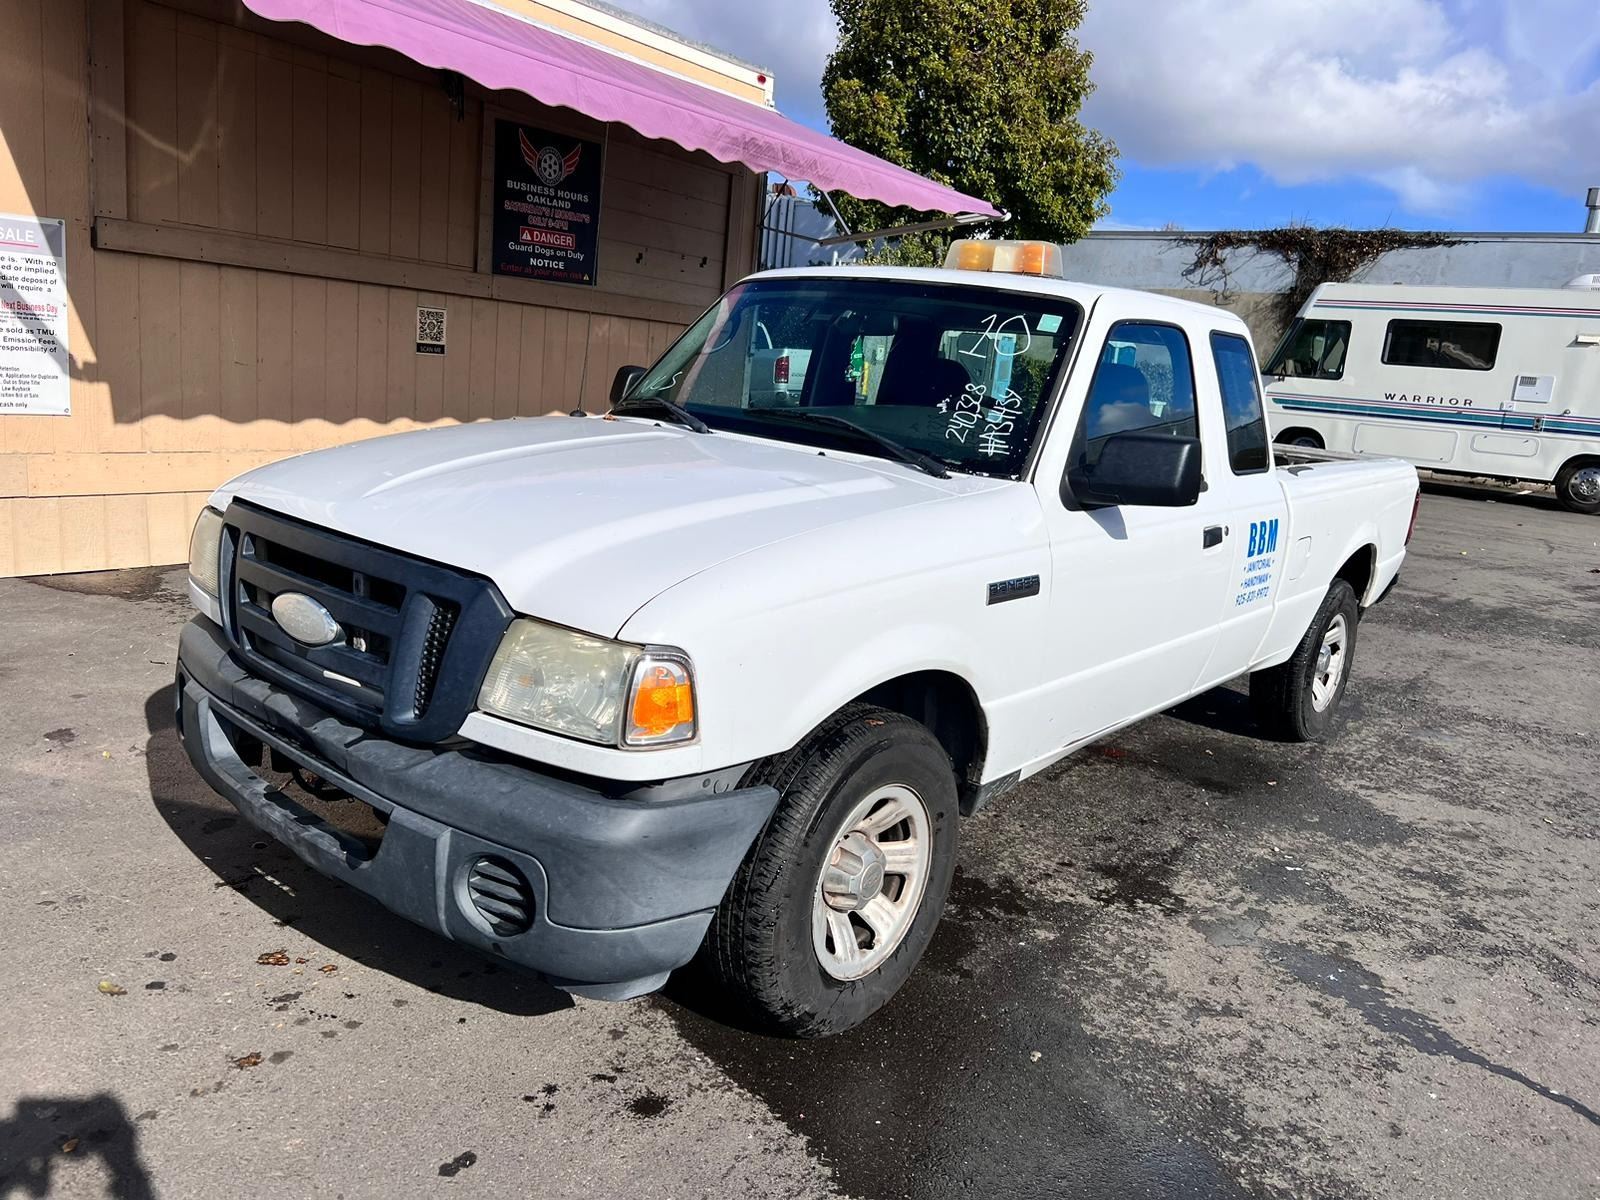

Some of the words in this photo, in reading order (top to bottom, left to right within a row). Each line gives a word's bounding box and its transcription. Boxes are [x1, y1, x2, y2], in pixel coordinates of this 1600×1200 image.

[506, 180, 555, 196] BUSINESS
[557, 189, 589, 203] HOURS
[526, 194, 571, 209] OAKLAND
[0, 227, 35, 243] SALE
[533, 231, 573, 247] DANGER
[508, 241, 533, 253] Guard
[534, 245, 554, 257] Dogs
[556, 249, 566, 257] on
[567, 250, 585, 261] Duty
[530, 257, 565, 270] NOTICE
[21, 275, 48, 284] deposit
[18, 284, 43, 292] require
[1, 300, 16, 310] Next
[17, 300, 46, 312] Business
[47, 303, 58, 314] Day
[3, 336, 37, 344] Emission
[958, 313, 1031, 359] 10
[1384, 393, 1473, 407] WARRIOR
[1247, 518, 1279, 558] BBM
